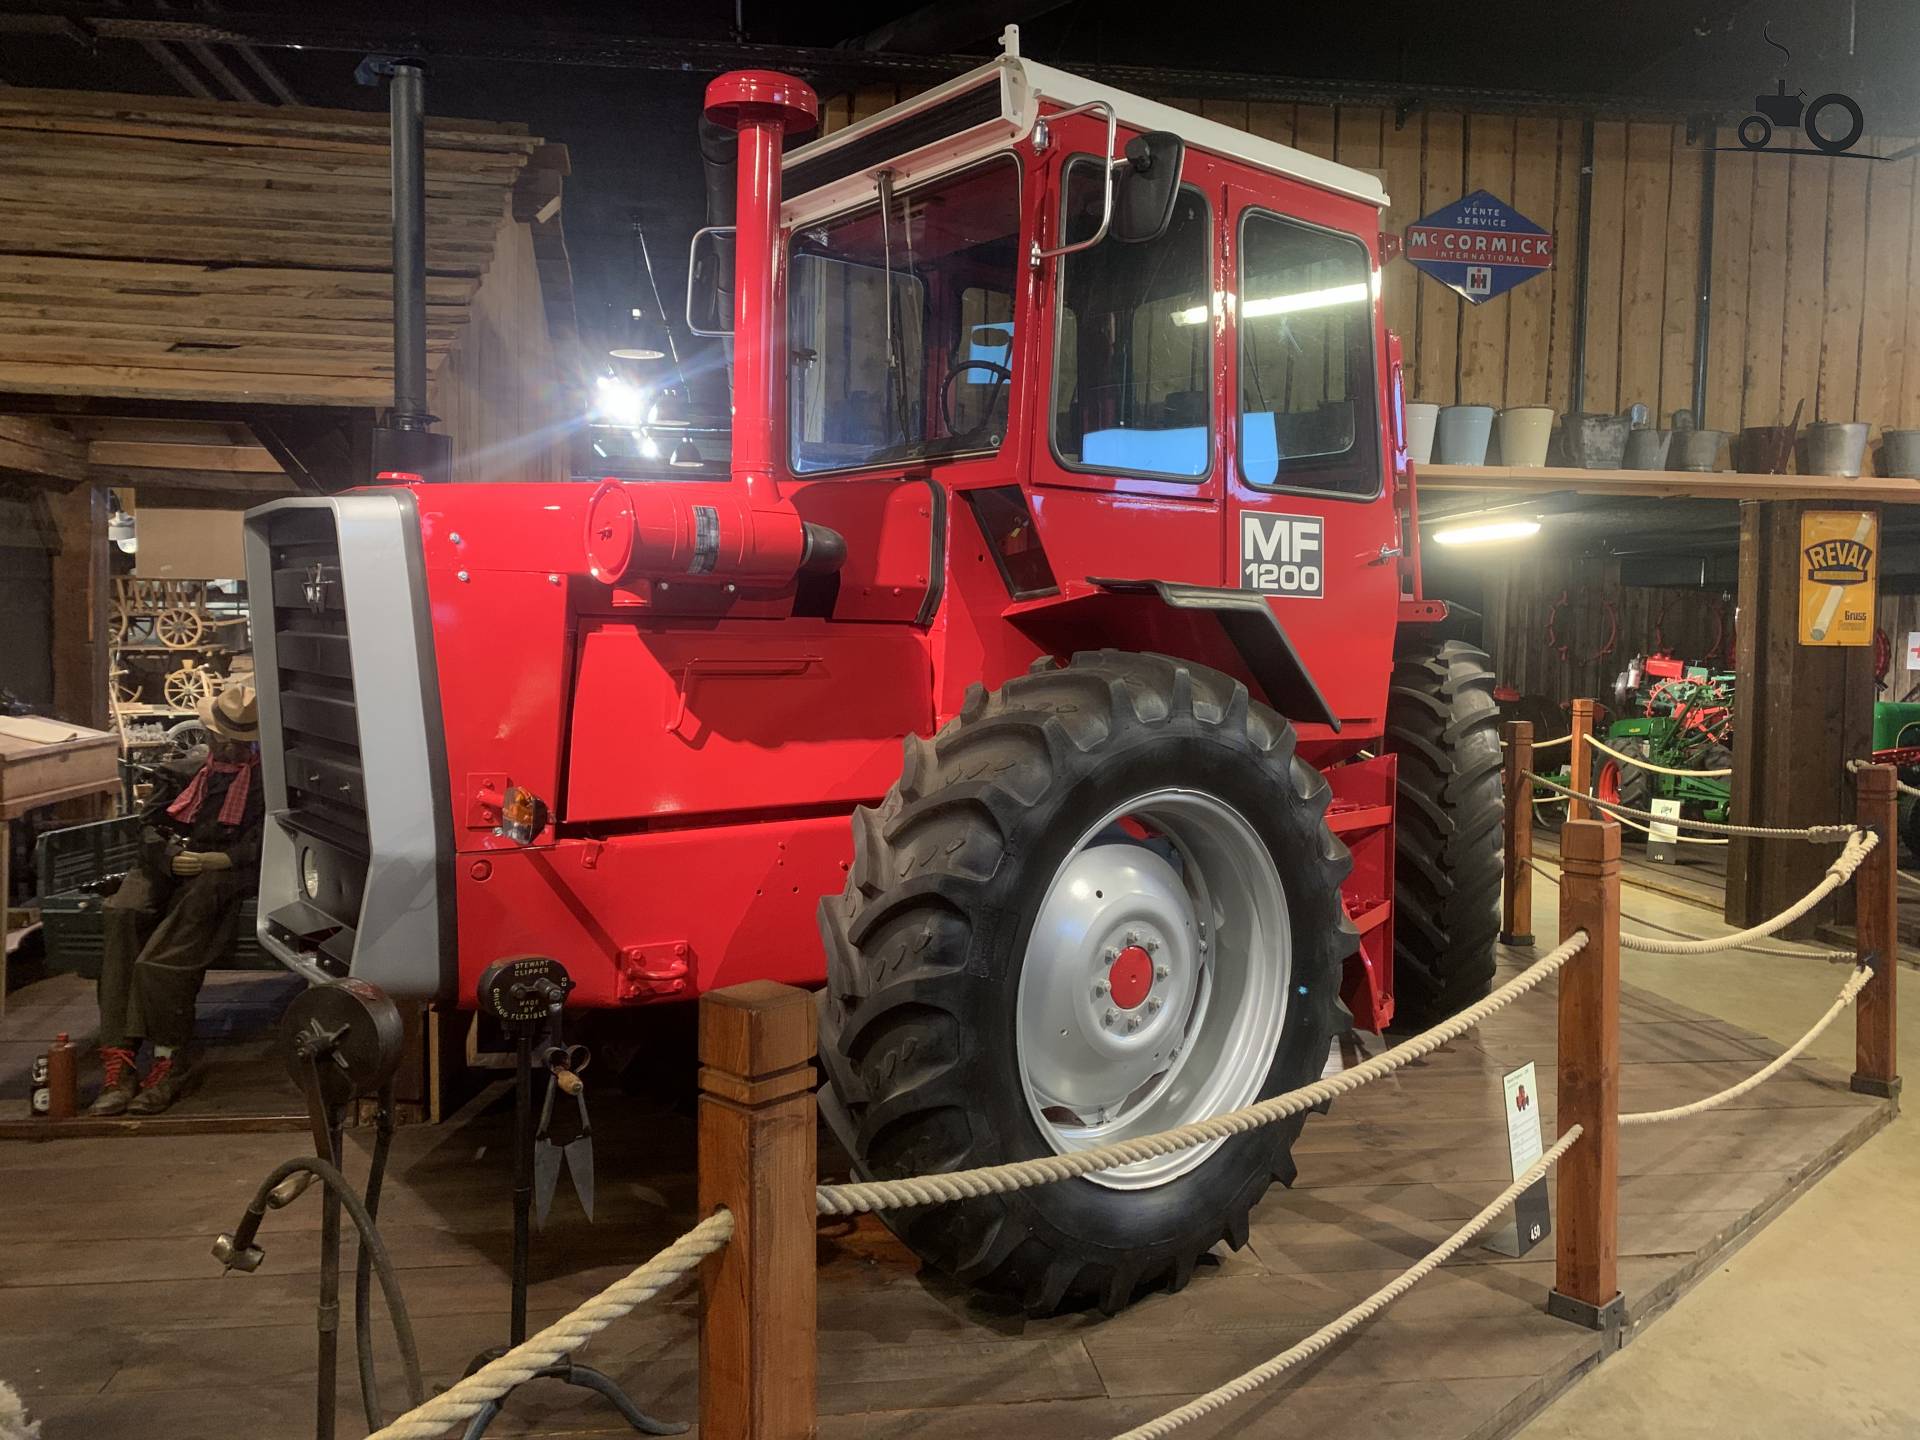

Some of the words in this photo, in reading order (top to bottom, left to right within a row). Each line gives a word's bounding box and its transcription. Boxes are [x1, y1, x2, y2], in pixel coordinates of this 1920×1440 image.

[1464, 207, 1500, 216] VENTE
[1456, 217, 1506, 227] SERVICE
[1436, 251, 1526, 264] INTERNATIONAL
[1244, 517, 1320, 563] MF
[1809, 542, 1868, 570] REVAL
[1244, 563, 1320, 591] 1200
[514, 960, 549, 970] STEWART
[514, 967, 549, 977] CLIPPER
[511, 1010, 547, 1020] FLEXIBLE
